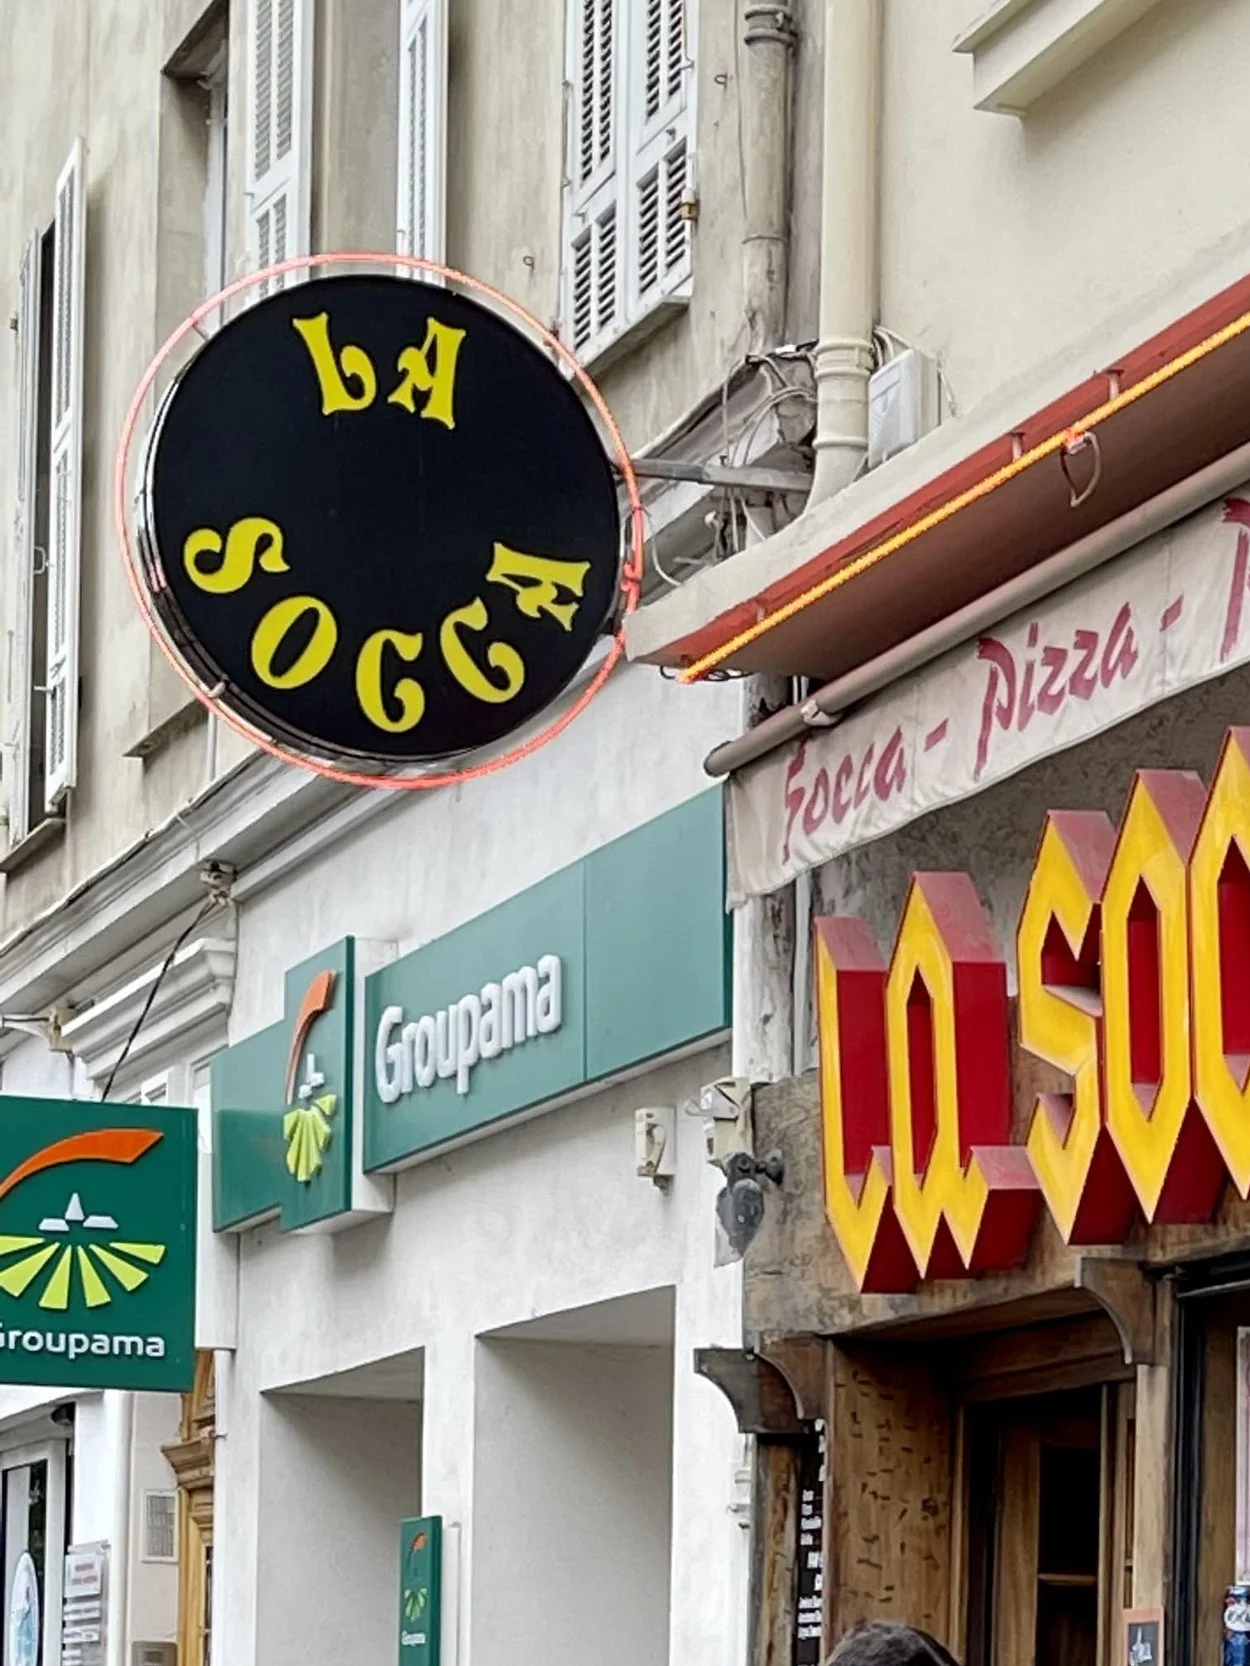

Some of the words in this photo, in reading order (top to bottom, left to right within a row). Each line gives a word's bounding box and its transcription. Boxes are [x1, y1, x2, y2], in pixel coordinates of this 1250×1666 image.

[293, 312, 466, 430] LA
[184, 516, 591, 733] SOCCA
[974, 602, 1138, 783] Pizza
[375, 954, 562, 1103] Groupama
